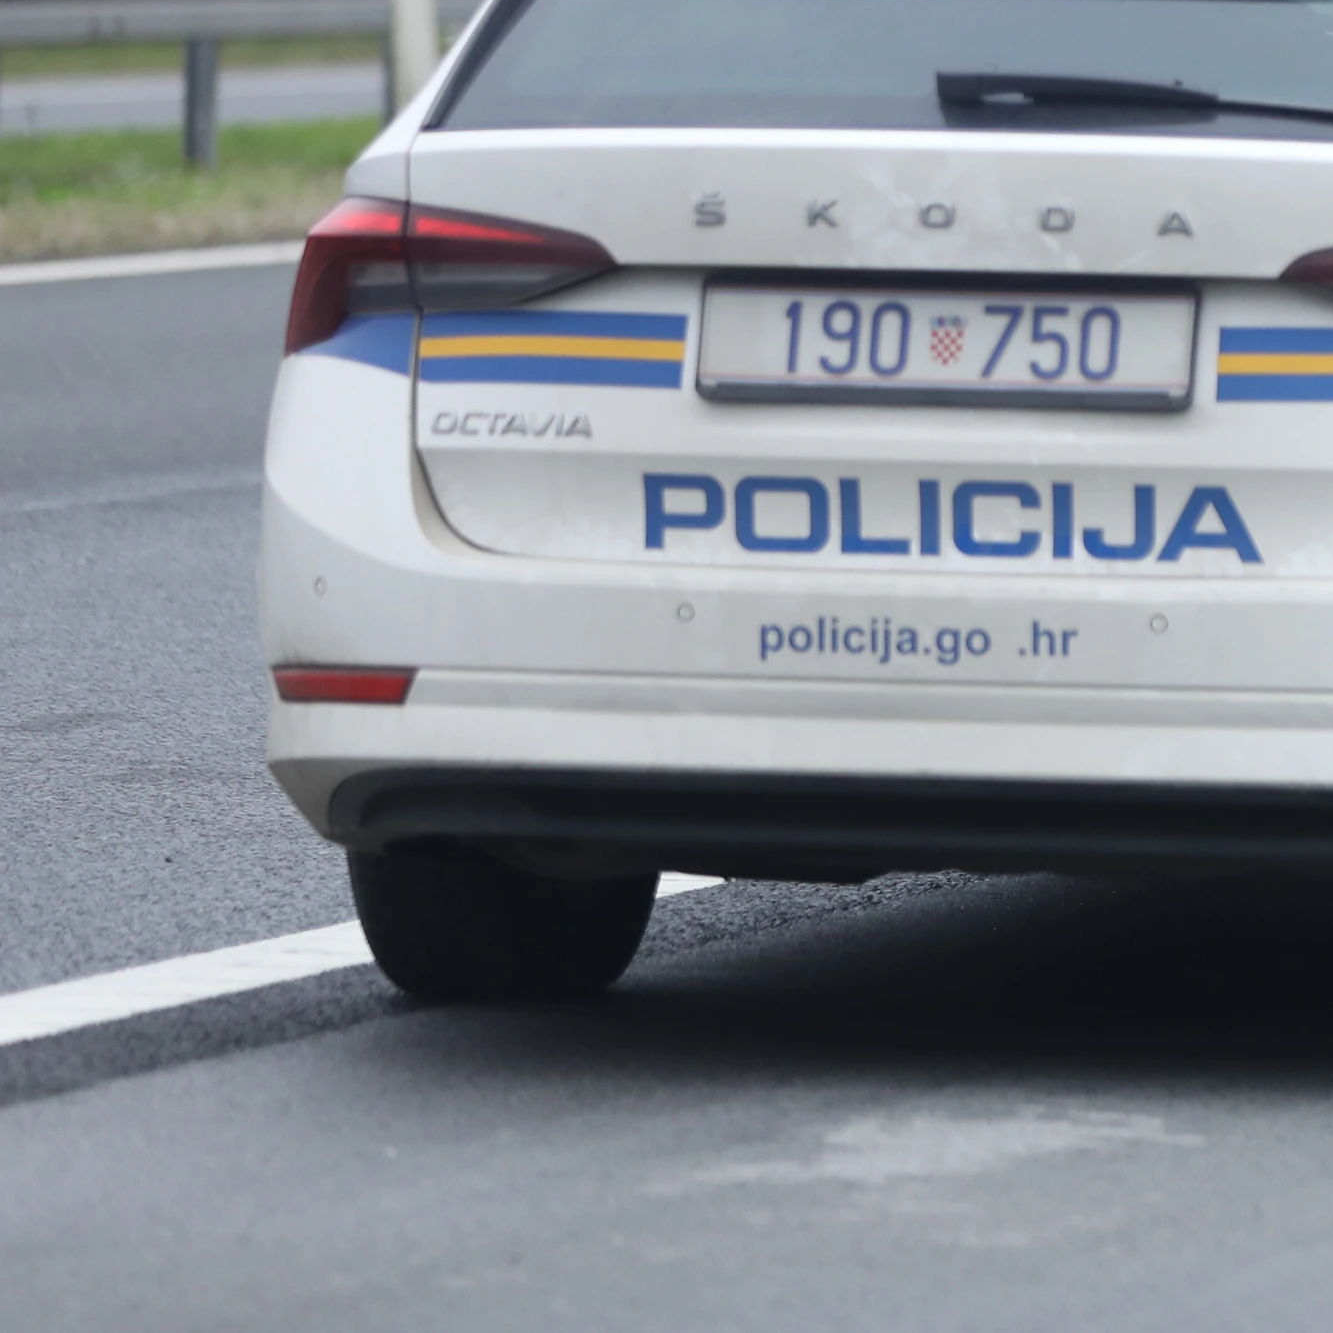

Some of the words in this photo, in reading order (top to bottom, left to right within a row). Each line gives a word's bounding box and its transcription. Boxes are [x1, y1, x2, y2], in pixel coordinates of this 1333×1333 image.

[693, 192, 1194, 238] ŠKODA
[785, 300, 911, 376] 190
[981, 304, 1122, 381] 750
[430, 408, 593, 439] OCTAVIA
[645, 473, 1262, 564] POLICIJA
[758, 617, 992, 666] policija.go
